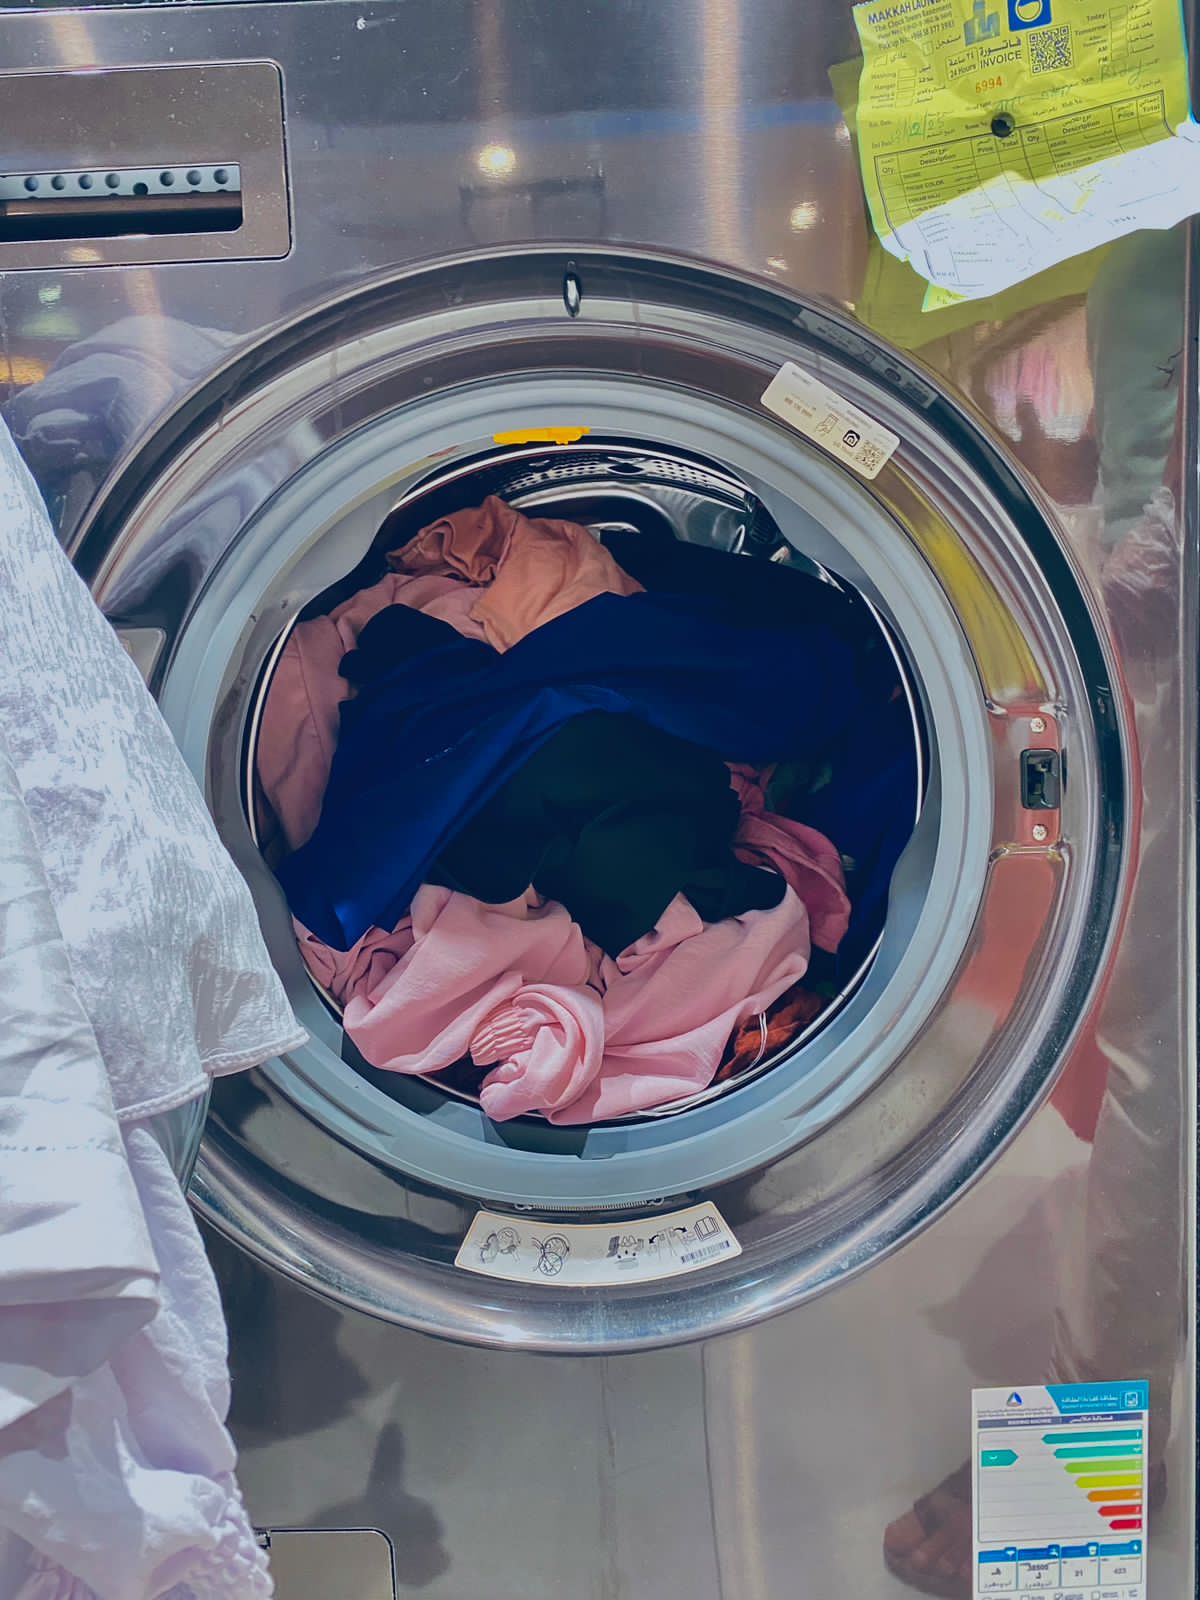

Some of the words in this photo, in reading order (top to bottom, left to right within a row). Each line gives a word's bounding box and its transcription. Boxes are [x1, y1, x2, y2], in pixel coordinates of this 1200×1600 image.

[868, 2, 912, 24] MAKKAH
[1074, 24, 1109, 36] Tomorrow
[980, 50, 1023, 69] INVOICE
[949, 69, 958, 78] 24
[958, 63, 977, 75] Hours
[1117, 110, 1135, 119] Price
[1143, 103, 1161, 113] Total
[1062, 120, 1101, 134] Description
[1001, 141, 1018, 149] Total
[1027, 135, 1040, 144] Qty
[919, 152, 956, 167] Description
